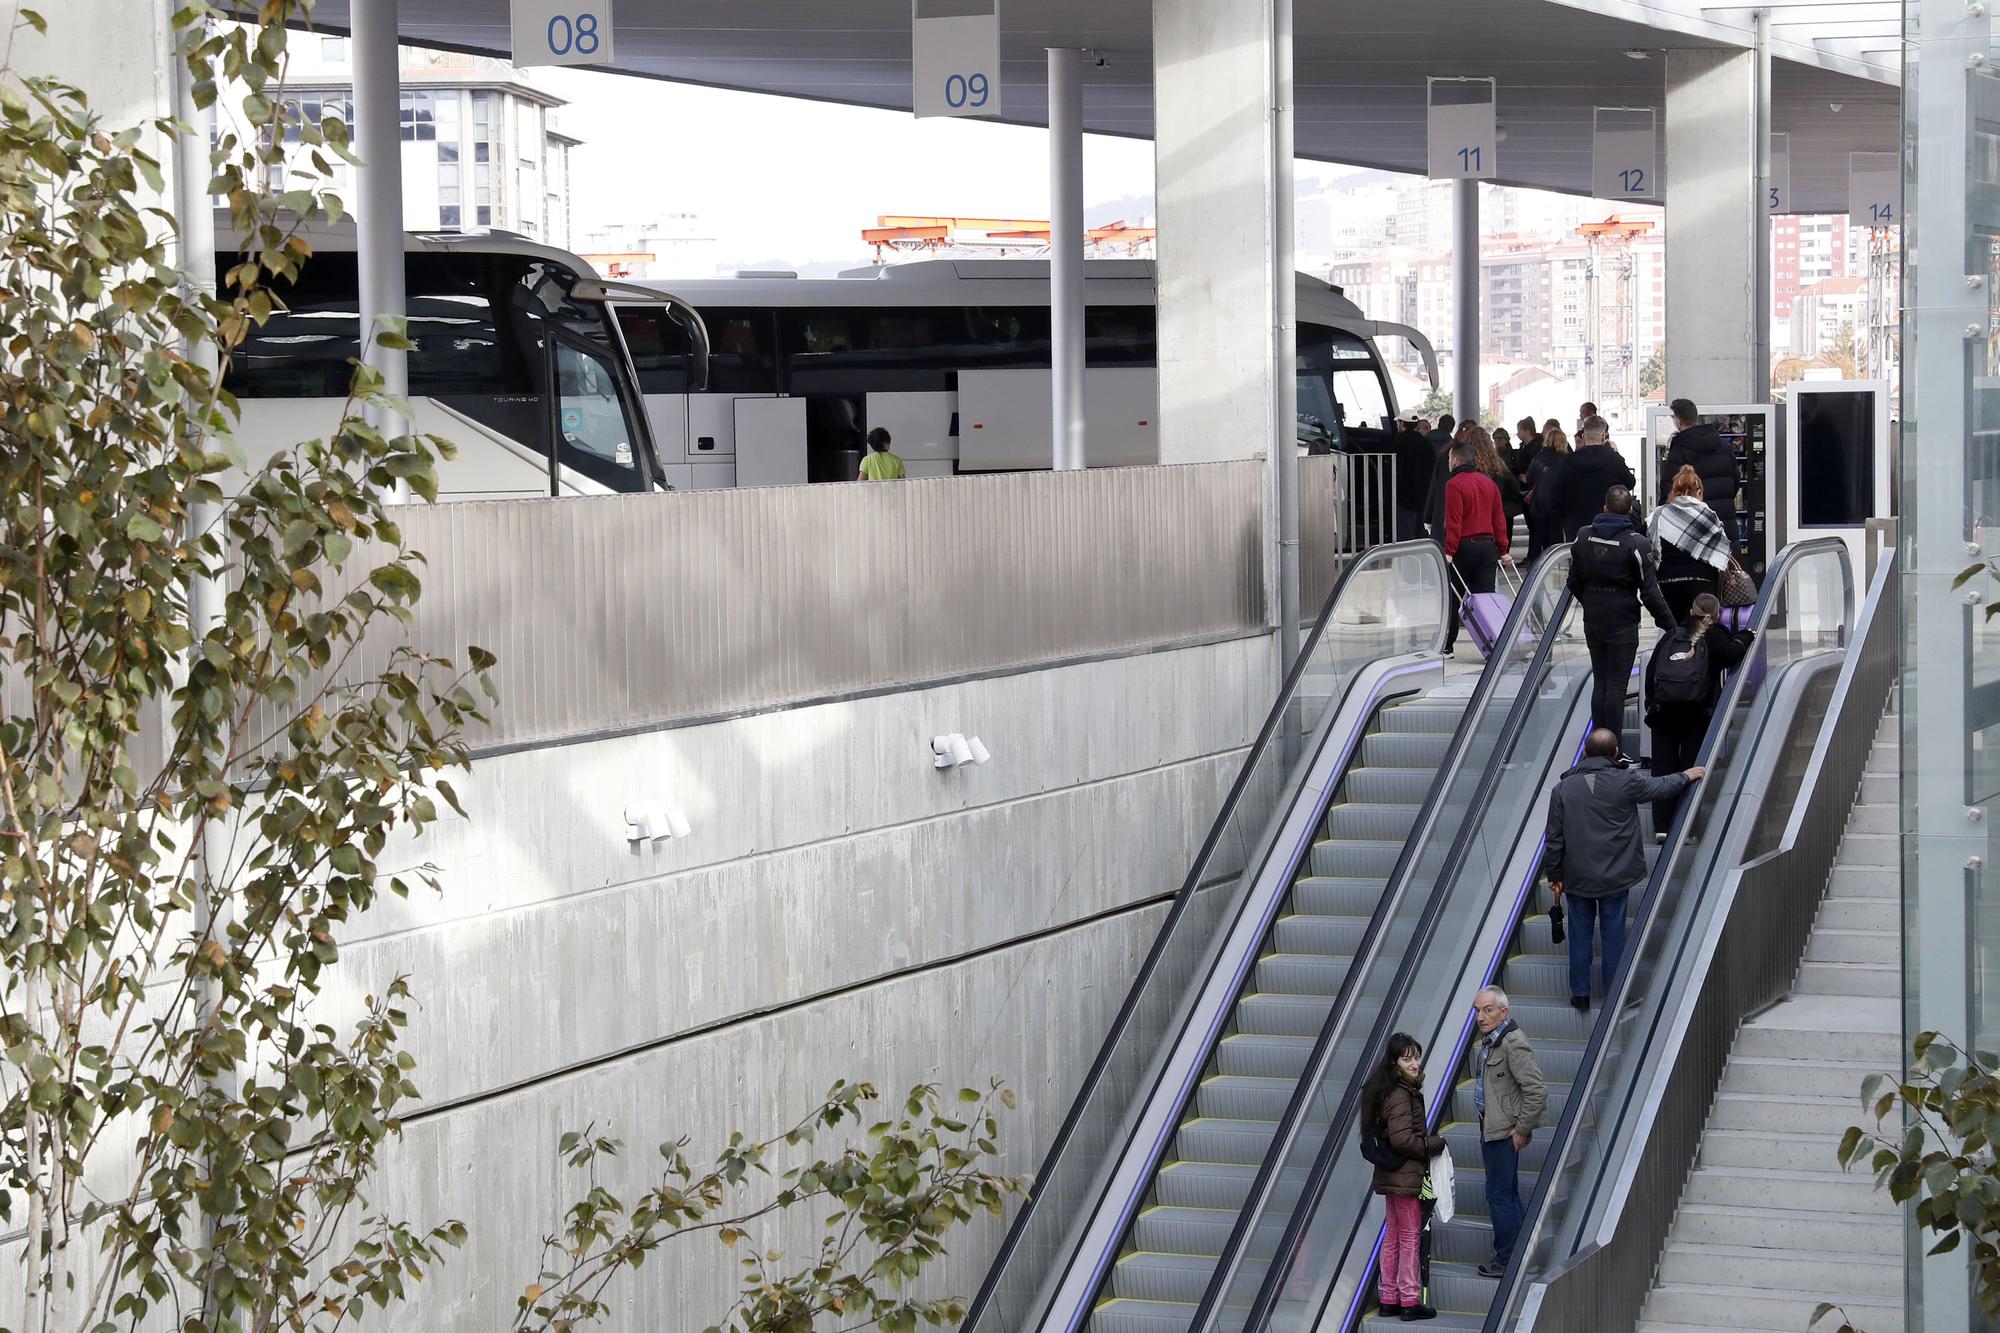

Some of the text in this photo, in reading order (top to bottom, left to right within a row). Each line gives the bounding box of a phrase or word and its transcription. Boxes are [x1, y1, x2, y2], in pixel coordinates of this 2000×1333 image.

[547, 13, 600, 56] 08
[945, 73, 989, 109] 09
[1457, 147, 1481, 172] 11
[1618, 169, 1644, 192] 12
[1769, 187, 1780, 209] 3
[1869, 203, 1893, 222] 14
